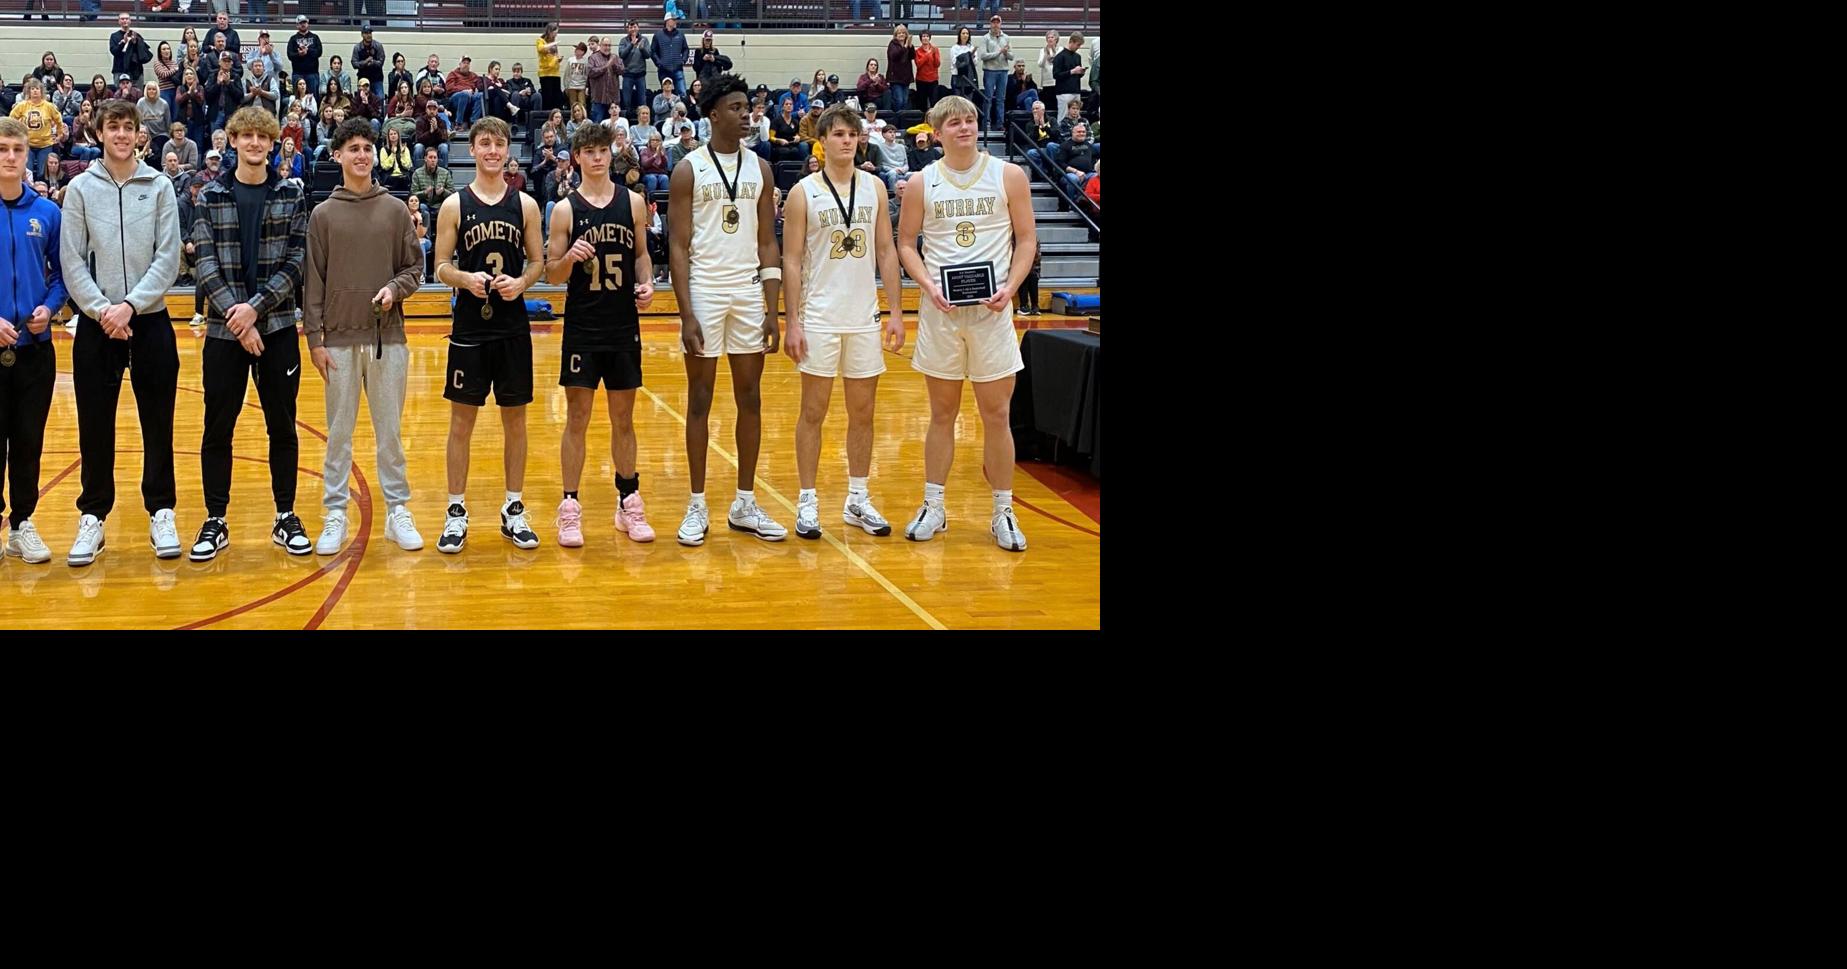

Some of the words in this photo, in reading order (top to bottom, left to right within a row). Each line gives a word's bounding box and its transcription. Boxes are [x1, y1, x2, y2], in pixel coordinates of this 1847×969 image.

[722, 204, 739, 234] 5
[934, 196, 996, 218] MURRAY
[464, 220, 521, 251] COMETS
[579, 223, 634, 249] OMETS
[830, 228, 867, 259] 23
[955, 221, 976, 247] 3
[486, 252, 504, 275] 3
[590, 254, 622, 291] 15
[570, 354, 581, 373] C
[453, 369, 464, 389] C
